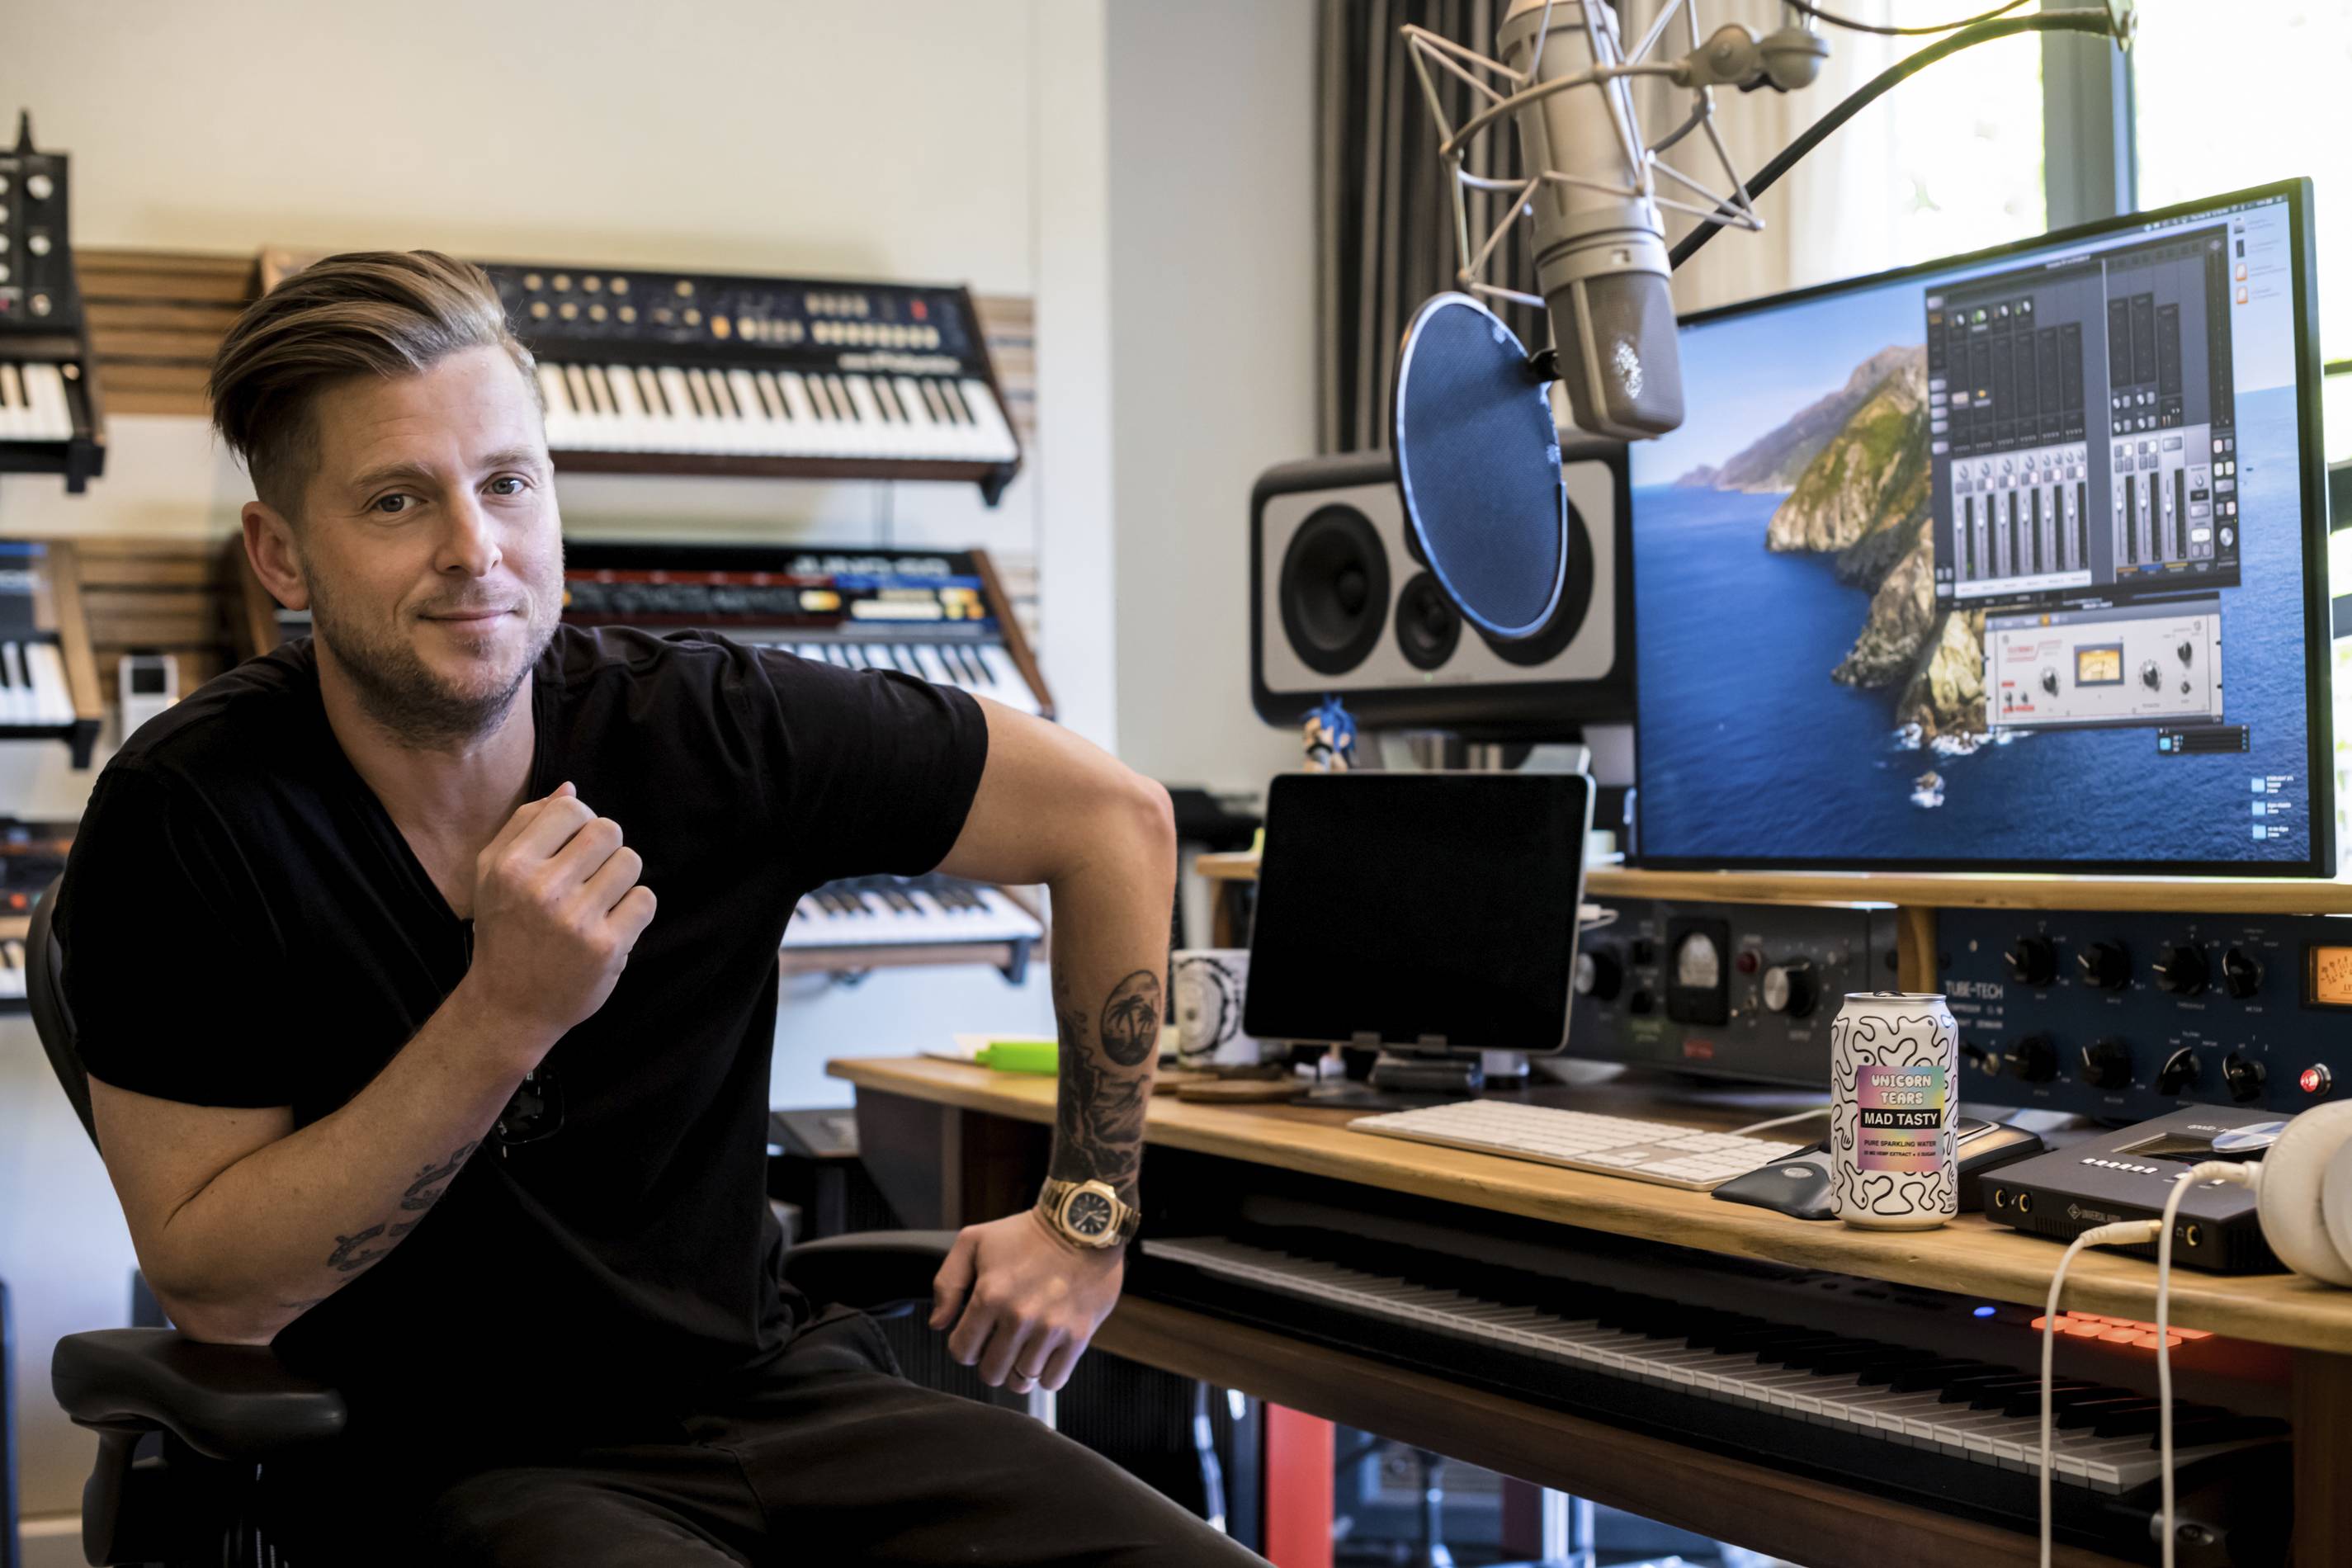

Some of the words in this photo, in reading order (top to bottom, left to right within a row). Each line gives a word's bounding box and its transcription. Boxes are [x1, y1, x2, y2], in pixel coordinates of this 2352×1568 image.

[1945, 980, 2004, 999] TUBE-TECH
[1871, 1074, 1932, 1088] UNICORN
[1880, 1090, 1924, 1105] TEARS
[1863, 1112, 1894, 1126] MAD
[1896, 1112, 1938, 1126] TASTY
